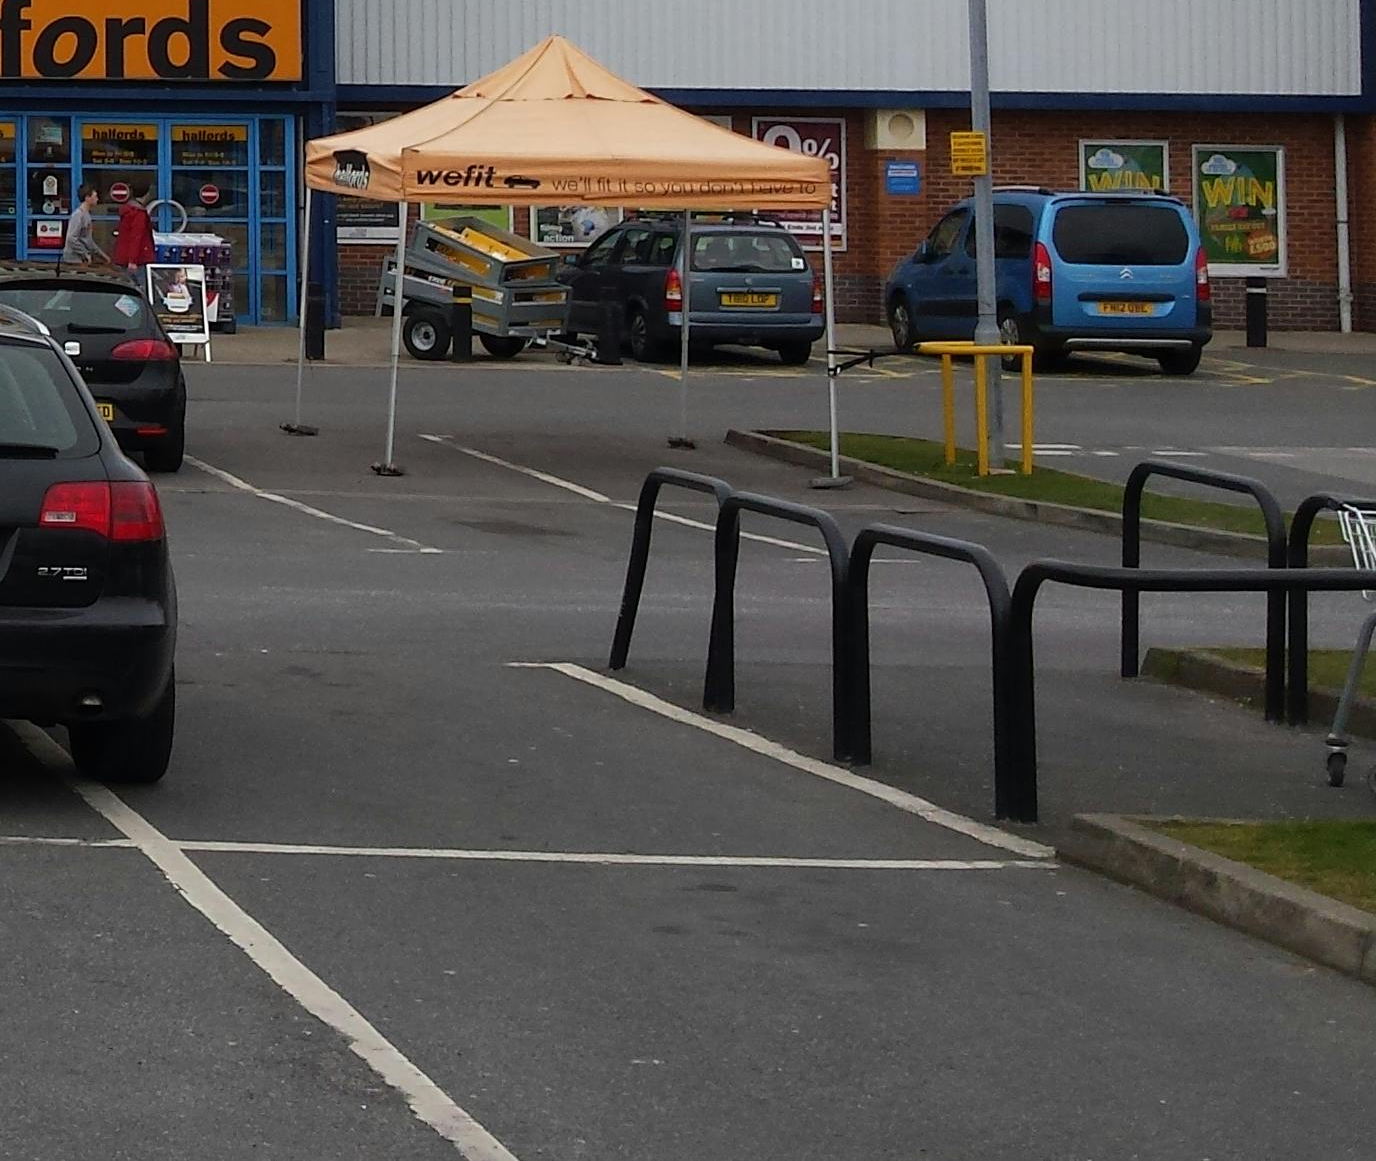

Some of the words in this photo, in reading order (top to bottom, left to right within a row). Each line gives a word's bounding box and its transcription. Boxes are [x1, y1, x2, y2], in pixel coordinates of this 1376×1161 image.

[92, 128, 145, 140] halfords
[182, 130, 235, 141] halfords
[417, 164, 497, 187] wefit
[1089, 170, 1160, 191] WIN
[552, 176, 592, 192] we'll
[596, 177, 612, 192] fit
[618, 179, 629, 193] it
[634, 181, 656, 194] so
[660, 182, 695, 197] you
[1202, 176, 1273, 208] WIN
